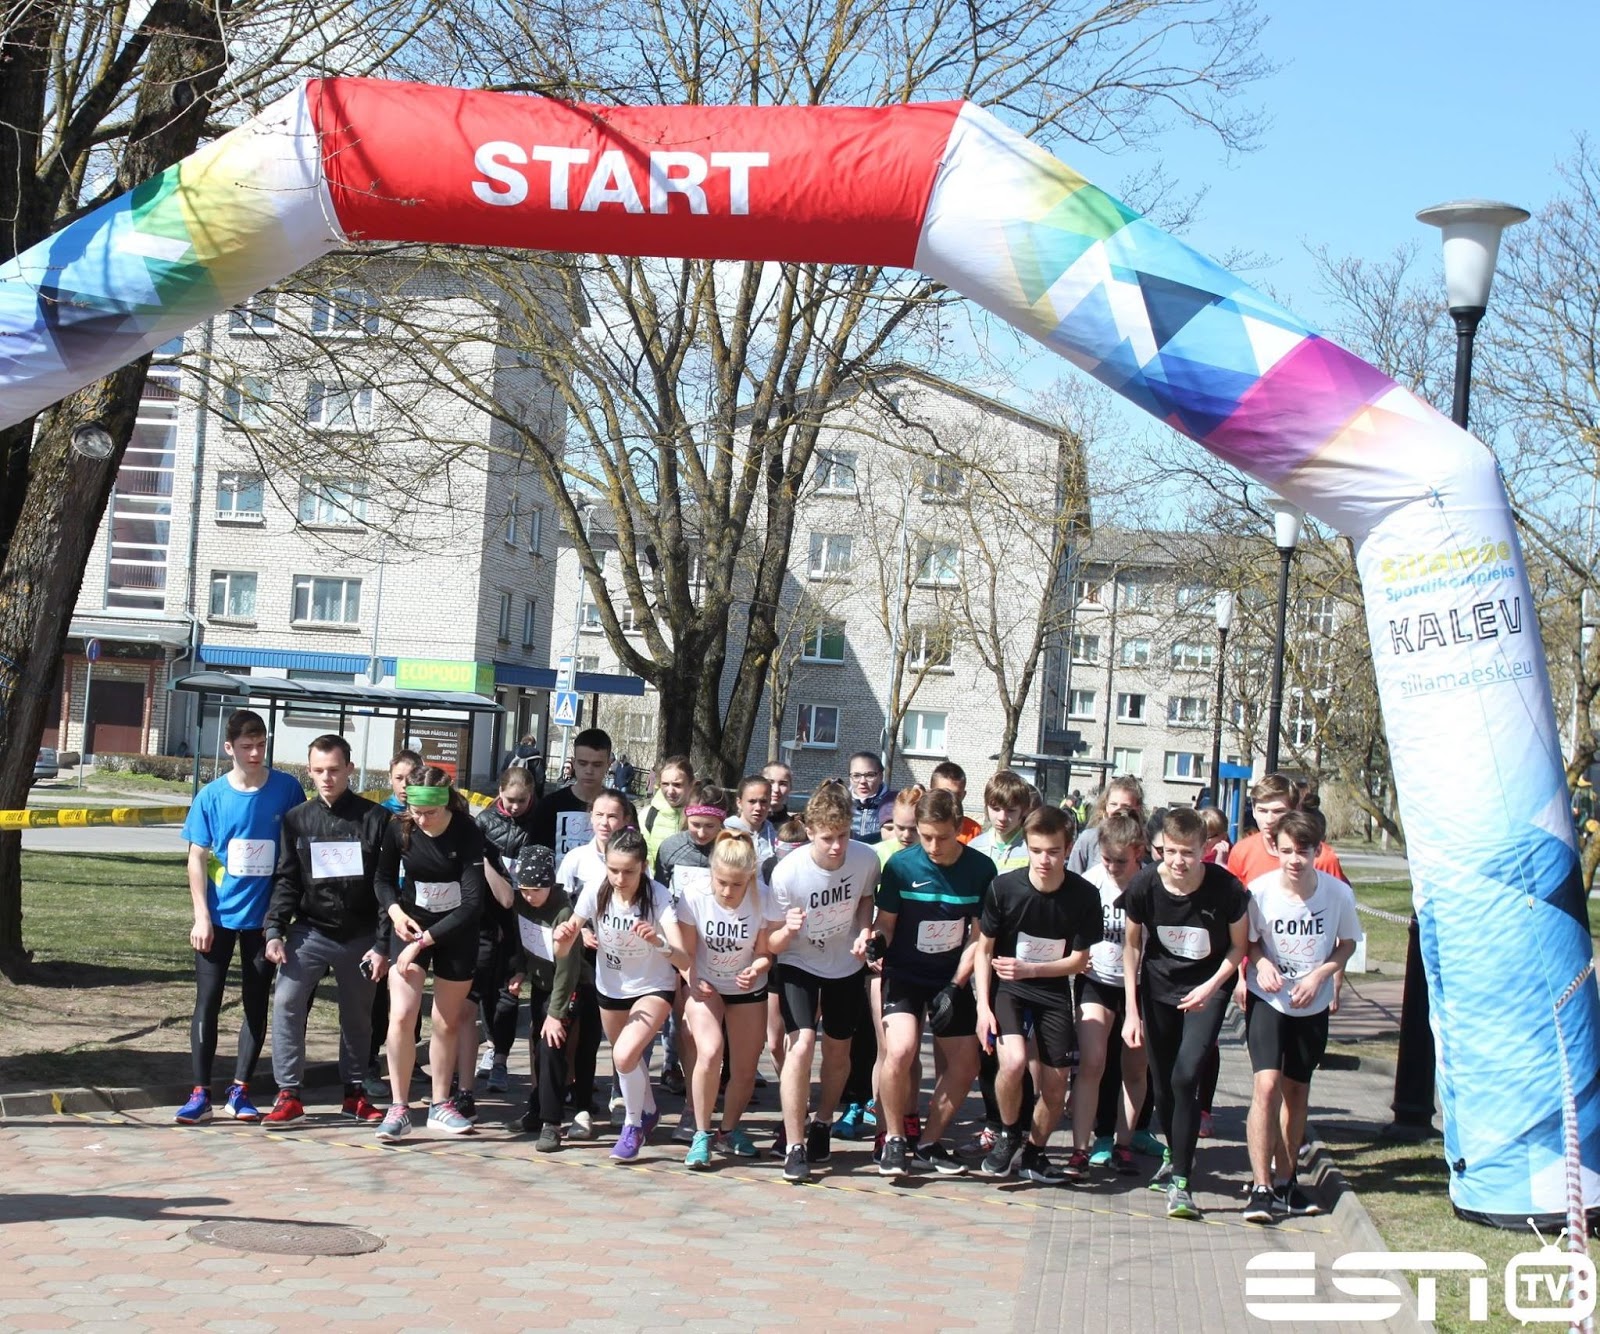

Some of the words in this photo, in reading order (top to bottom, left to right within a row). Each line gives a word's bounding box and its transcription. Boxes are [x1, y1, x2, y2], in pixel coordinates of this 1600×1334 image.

[472, 141, 769, 215] START
[1389, 597, 1522, 655] KALEV
[400, 662, 472, 684] ECOPOOD
[1401, 659, 1532, 695] sillamaesk.eu
[320, 848, 353, 866] 339
[422, 887, 450, 899] 341
[810, 883, 852, 909] COME
[603, 914, 634, 931] COM
[706, 920, 749, 939] COME
[1274, 918, 1325, 936] COME
[604, 930, 637, 948] 332
[1168, 930, 1200, 943] 340
[1023, 940, 1055, 957] 343
[1279, 938, 1317, 957] 328
[710, 953, 742, 968] 346
